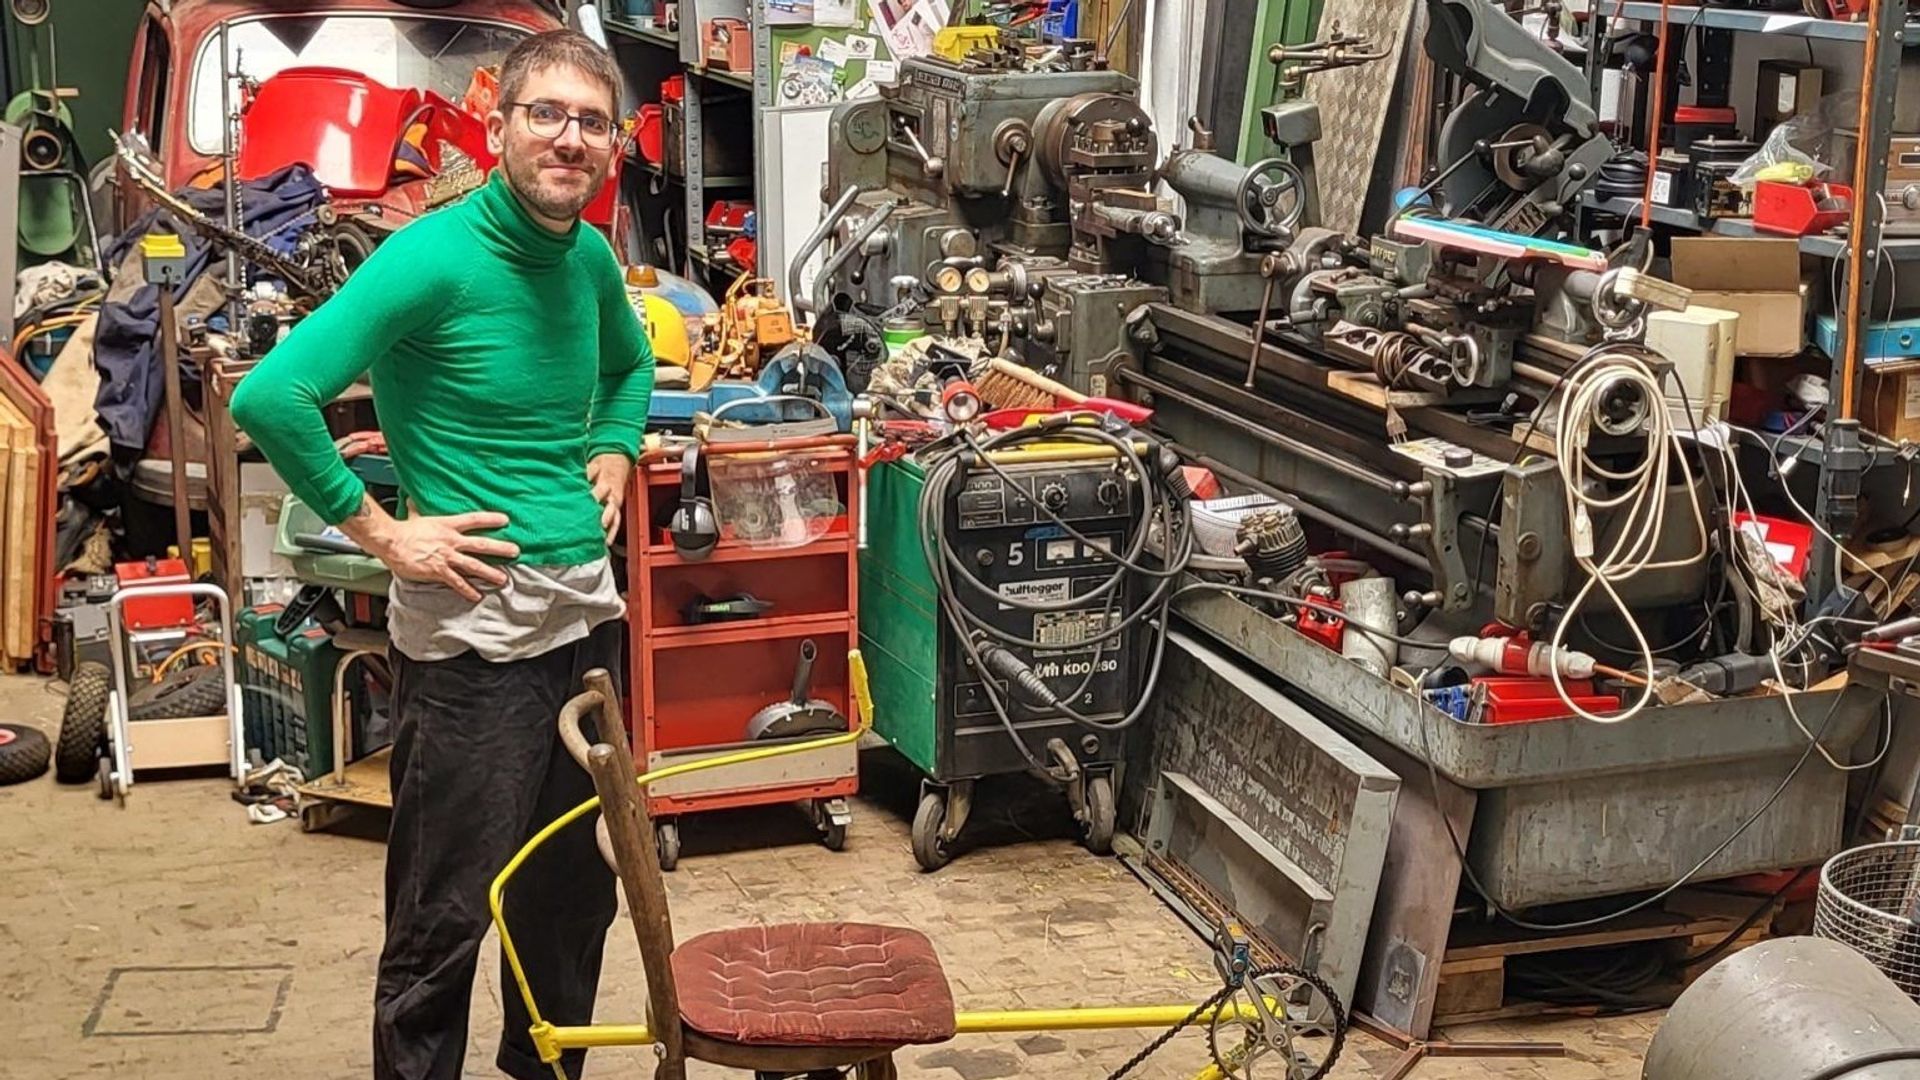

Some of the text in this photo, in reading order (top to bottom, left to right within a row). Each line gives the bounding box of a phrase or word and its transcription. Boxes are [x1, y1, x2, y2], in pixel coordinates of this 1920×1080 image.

[1008, 542, 1024, 565] 5
[1062, 661, 1091, 676] KDO
[1084, 692, 1093, 704] 2
